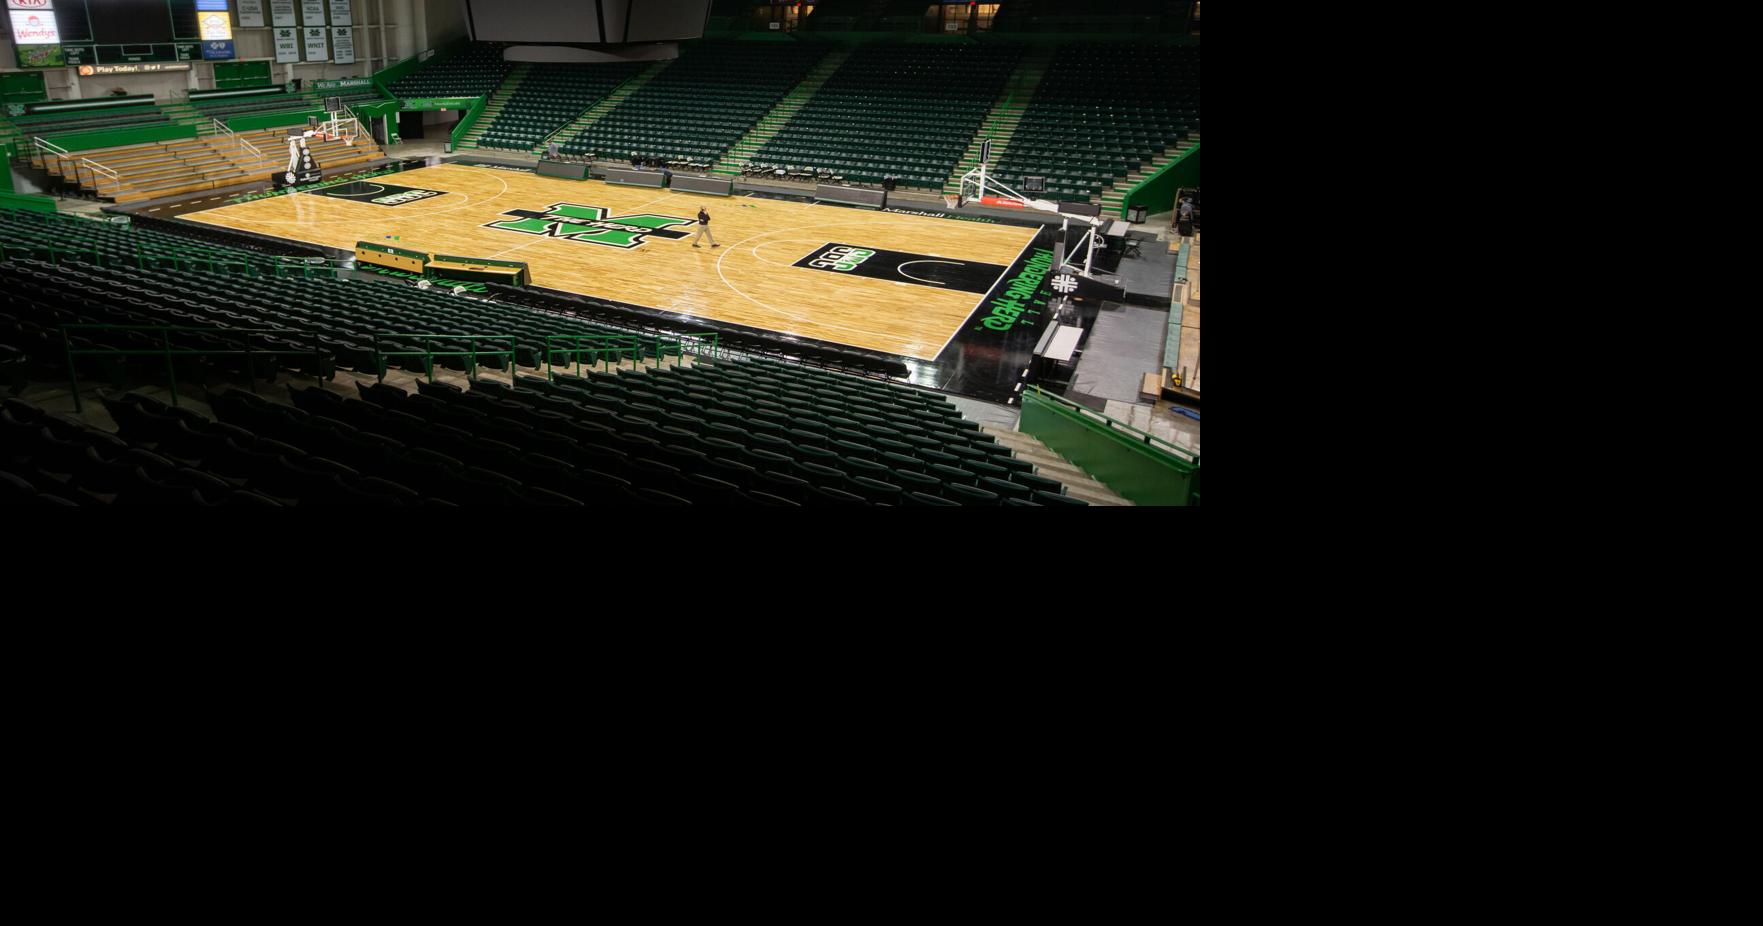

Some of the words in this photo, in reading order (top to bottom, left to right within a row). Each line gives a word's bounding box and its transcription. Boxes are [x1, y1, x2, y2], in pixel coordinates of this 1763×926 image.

[882, 207, 945, 218] Marshall
[586, 221, 653, 233] HERD
[1004, 247, 1054, 300] THUNDERING
[980, 297, 1026, 331] HERD
